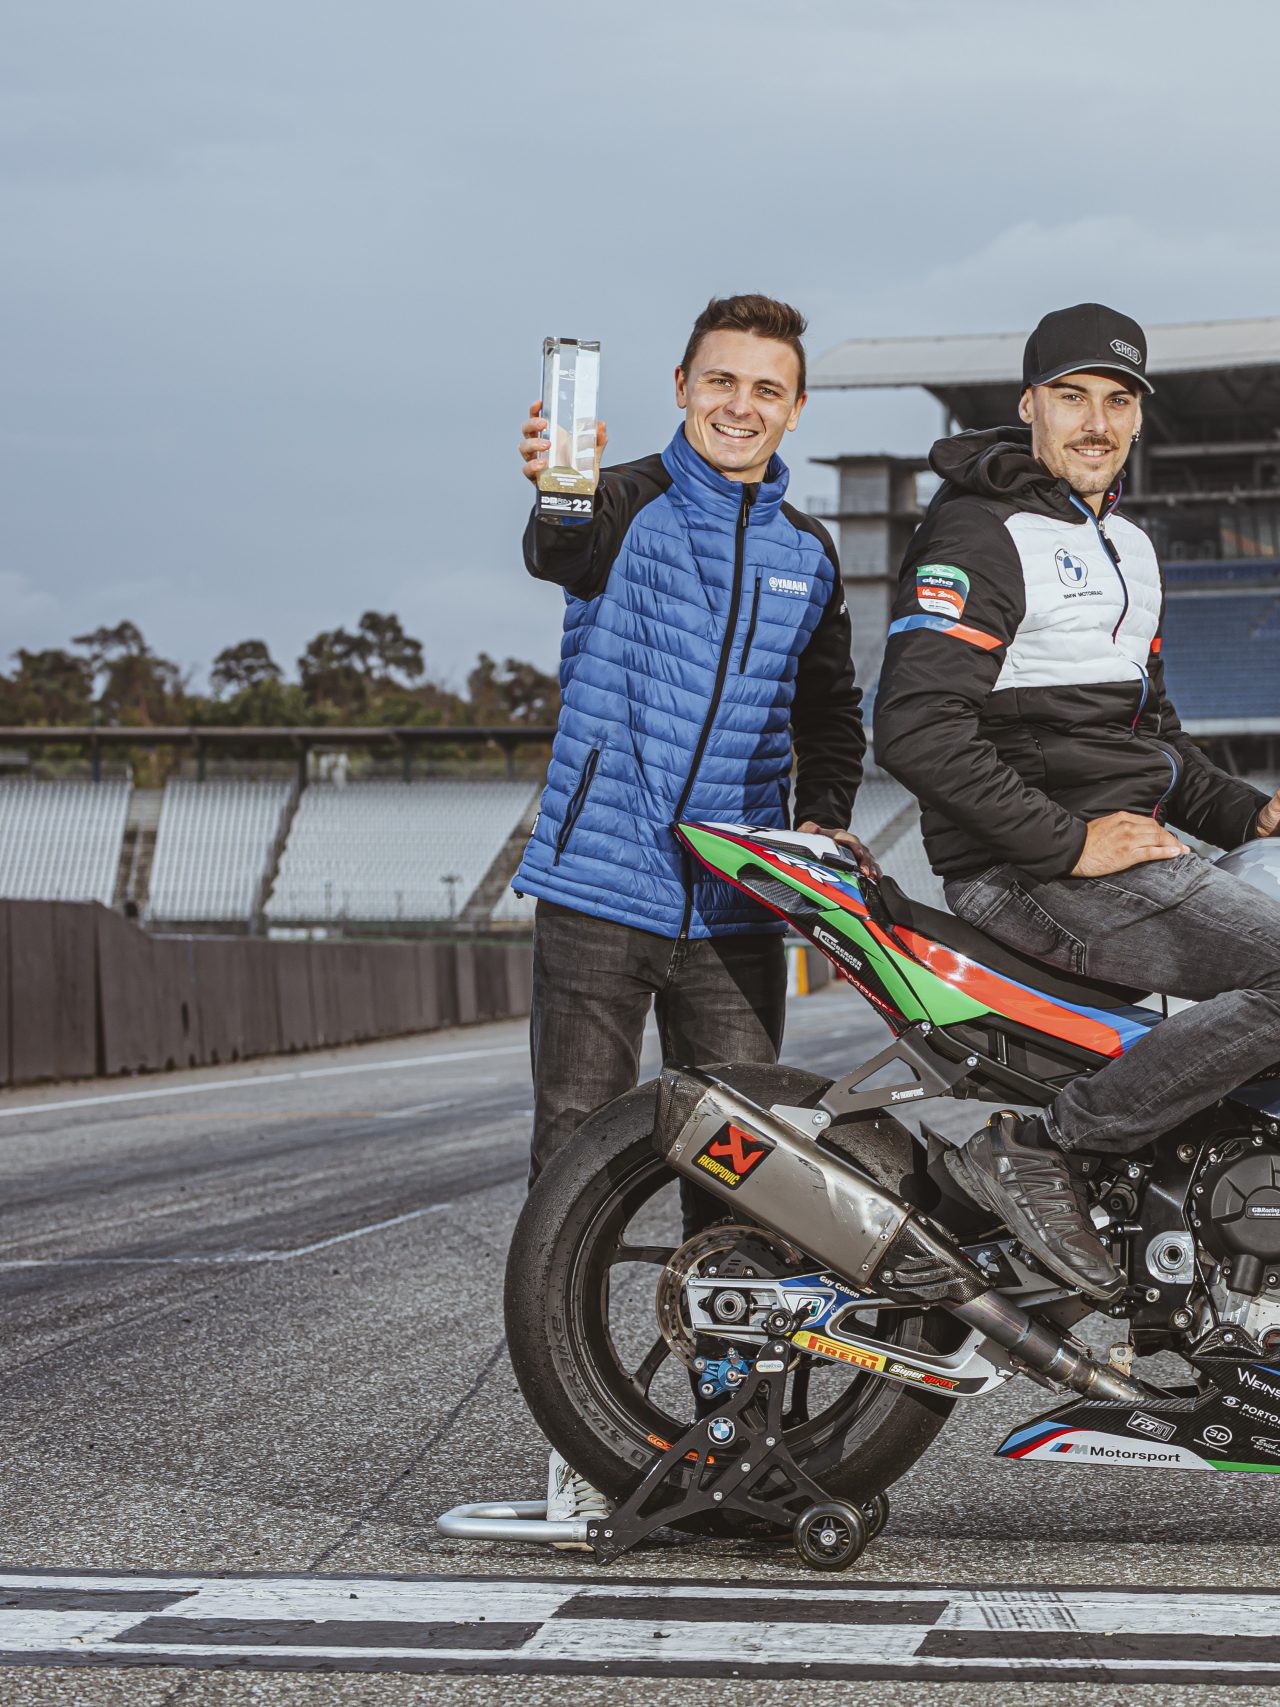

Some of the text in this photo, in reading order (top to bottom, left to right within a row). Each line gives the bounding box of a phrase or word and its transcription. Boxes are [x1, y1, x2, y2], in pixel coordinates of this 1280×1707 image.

[572, 499, 592, 512] 22
[777, 579, 808, 592] YAMAHA
[922, 577, 954, 586] alpha
[819, 1275, 860, 1299] Guy Colson
[808, 1335, 880, 1370] PIRELLI
[1206, 1428, 1229, 1441] 3D
[1090, 1446, 1181, 1462] Motorsport
